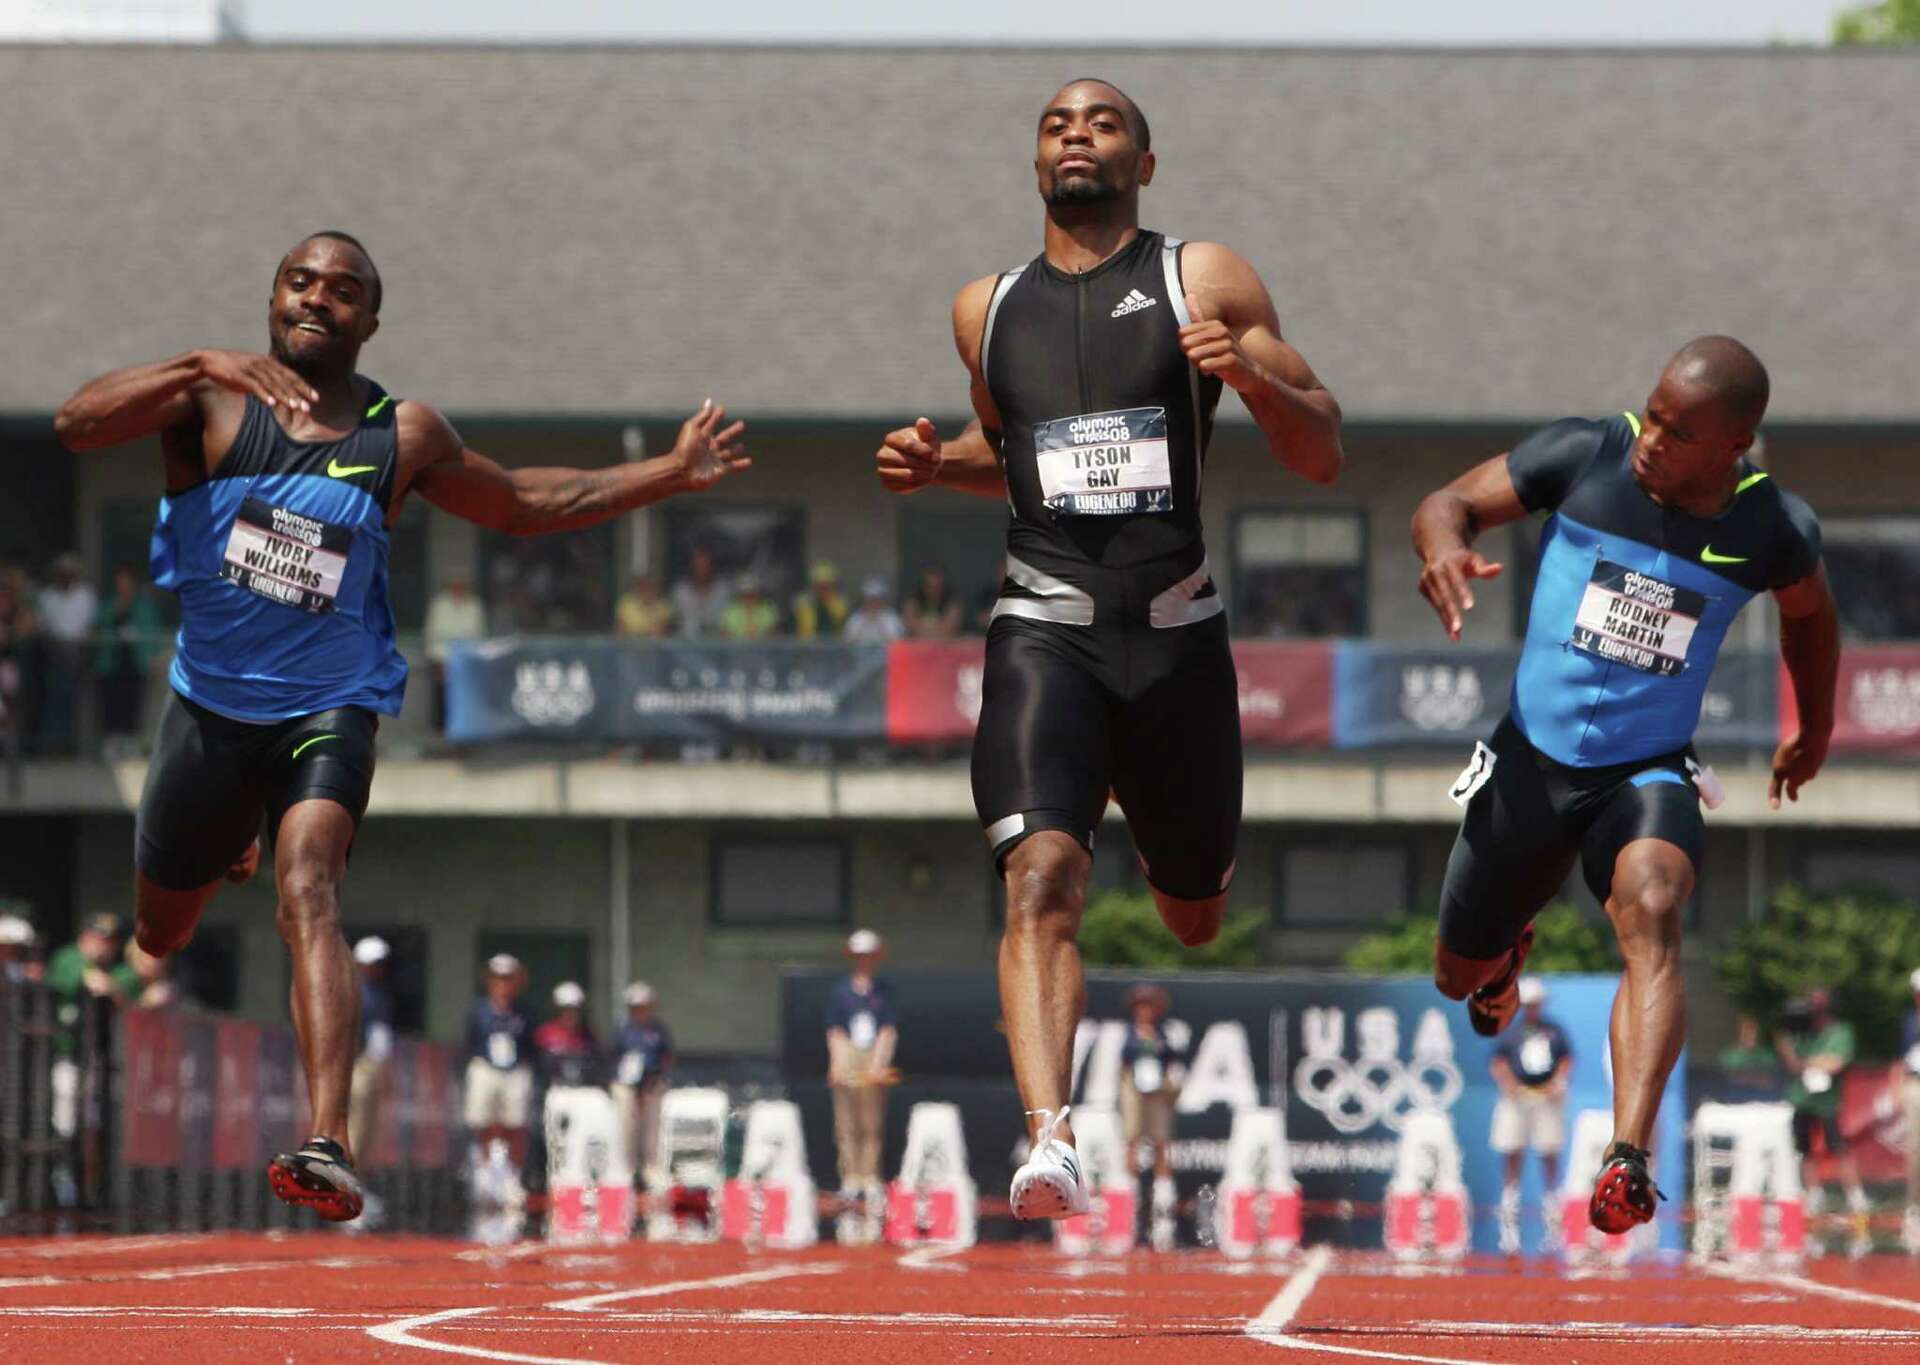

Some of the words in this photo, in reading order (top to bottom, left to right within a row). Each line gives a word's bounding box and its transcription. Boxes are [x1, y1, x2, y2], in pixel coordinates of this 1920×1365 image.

[1111, 298, 1157, 318] adidas
[1069, 416, 1126, 434] olympic
[1072, 446, 1132, 468] TYSON
[1087, 468, 1120, 488] GAY
[272, 508, 323, 534] olympic
[265, 535, 314, 564] IVORY
[244, 548, 323, 588] WILLIAMS
[1624, 572, 1676, 597] olympic
[1609, 598, 1671, 630] RODNEY
[1602, 616, 1664, 649] MARTIN
[1303, 1006, 1453, 1060] USA
